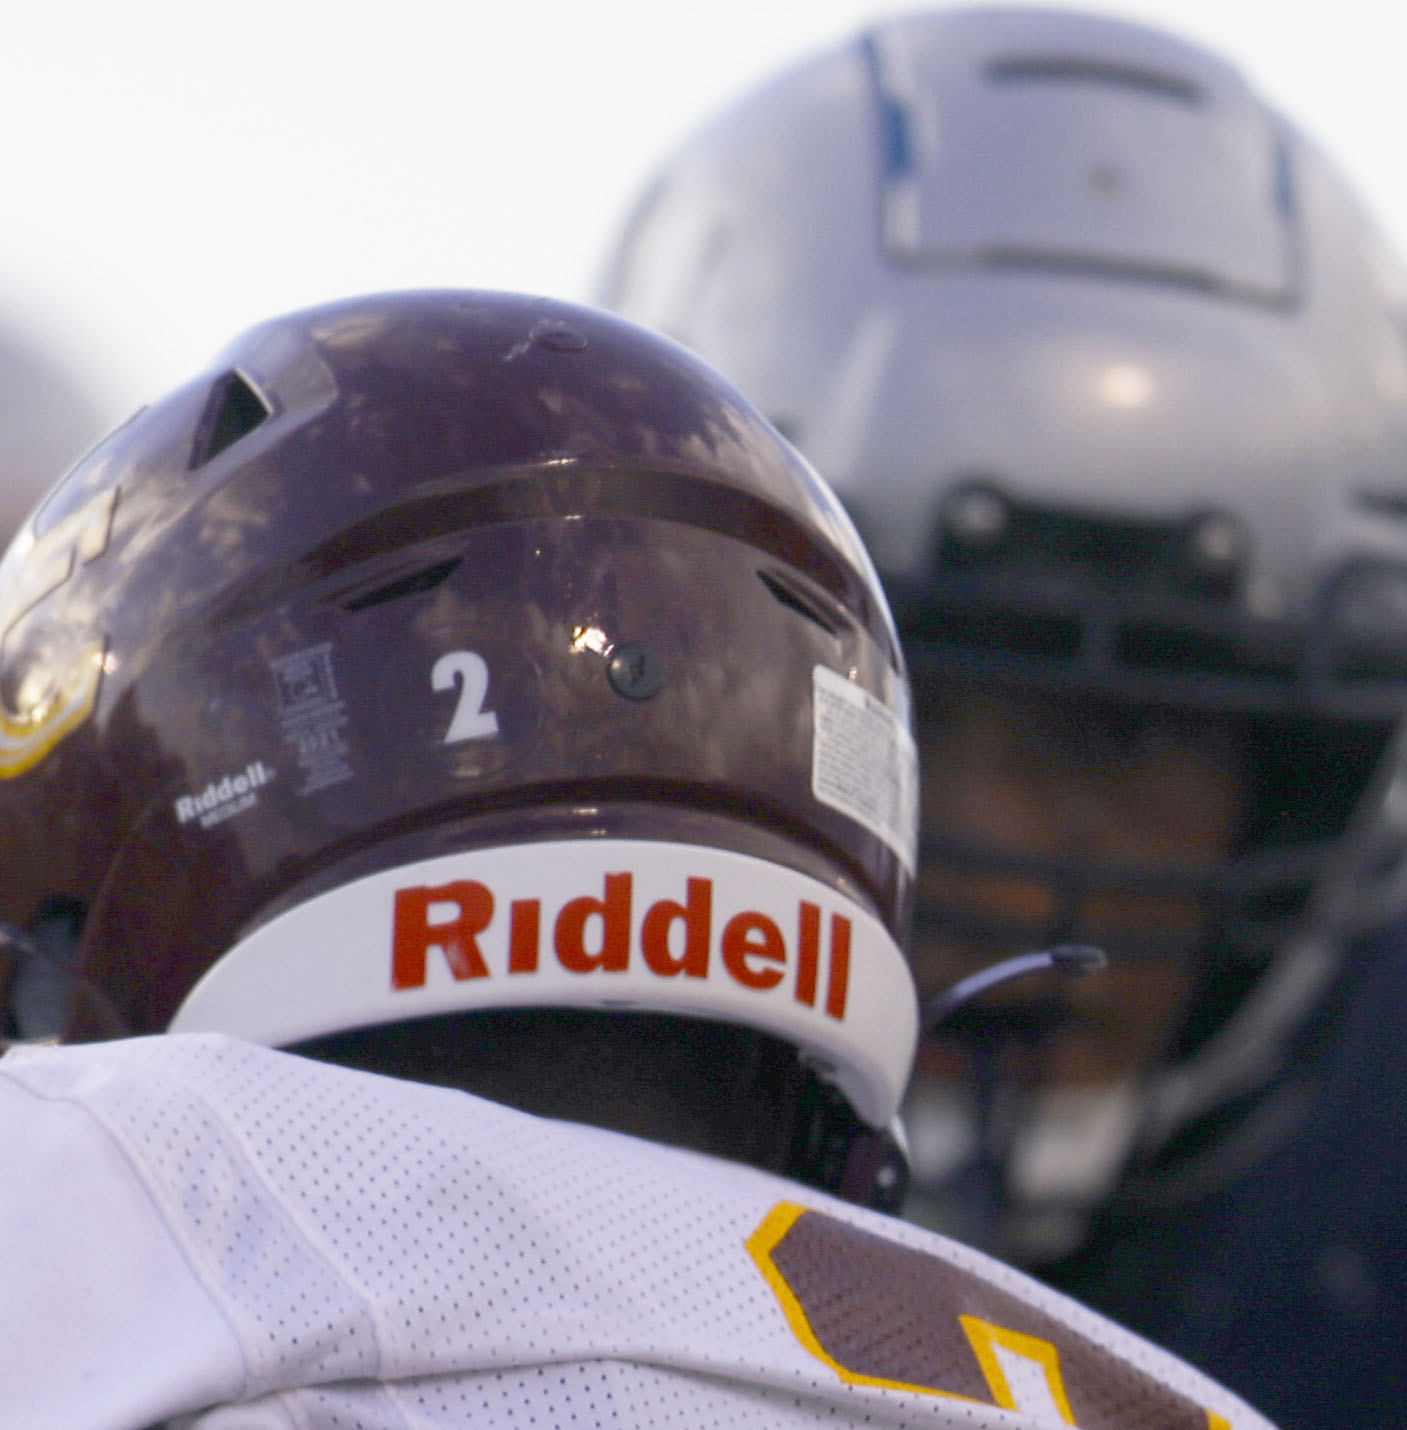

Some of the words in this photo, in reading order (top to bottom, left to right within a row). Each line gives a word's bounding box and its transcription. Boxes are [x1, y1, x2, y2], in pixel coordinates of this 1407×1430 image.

[431, 650, 499, 744] 2
[175, 760, 268, 824] Riddell
[392, 870, 852, 1021] Riddell
